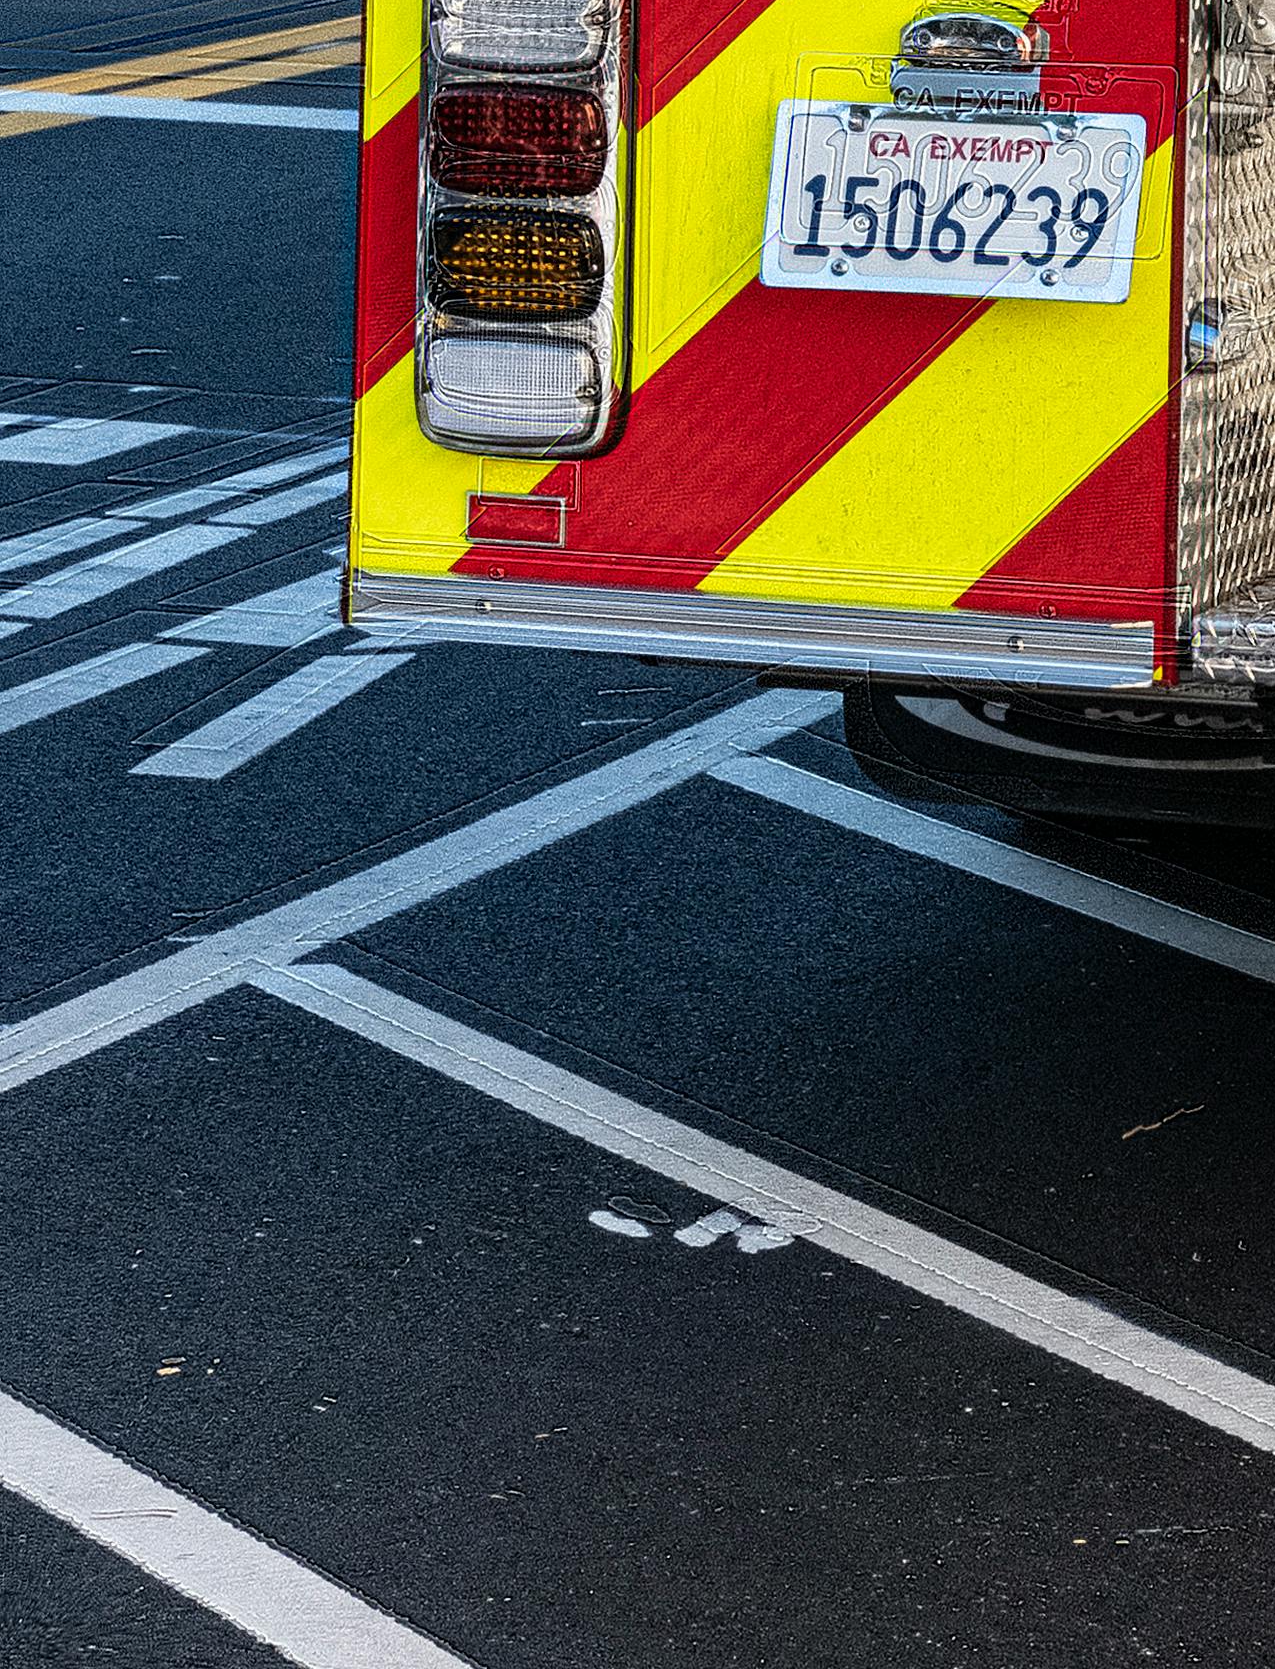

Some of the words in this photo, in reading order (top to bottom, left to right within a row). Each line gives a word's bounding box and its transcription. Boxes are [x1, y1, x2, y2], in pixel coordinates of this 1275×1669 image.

[869, 133, 911, 158] CA
[929, 136, 1054, 165] EXEMPT
[793, 174, 1109, 269] 1506239
